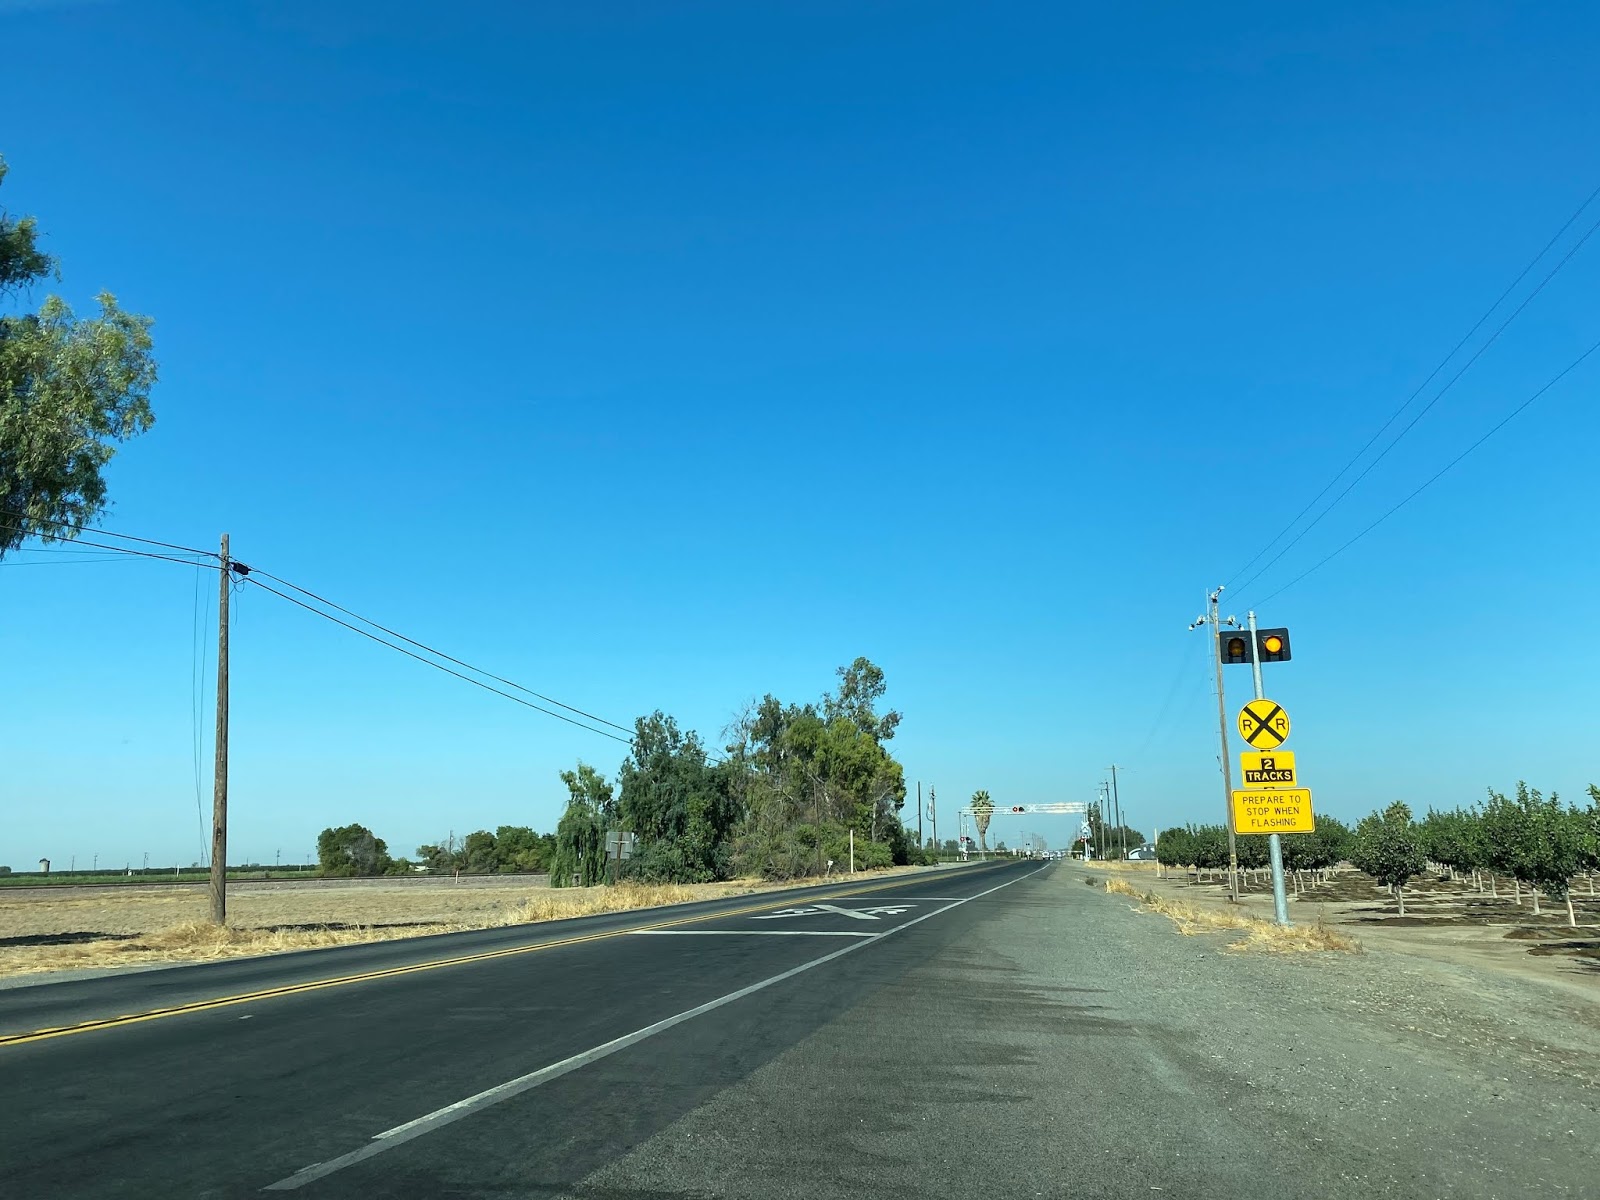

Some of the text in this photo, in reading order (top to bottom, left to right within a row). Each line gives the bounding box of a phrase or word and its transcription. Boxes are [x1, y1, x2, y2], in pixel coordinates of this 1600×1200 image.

[1243, 718, 1286, 730] R R
[1263, 759, 1273, 769] 2
[1247, 771, 1291, 781] TRACKS
[1242, 795, 1301, 804] PREPARE TO
[1246, 806, 1300, 816] STOP WHEN
[1251, 818, 1297, 827] FLASHING
